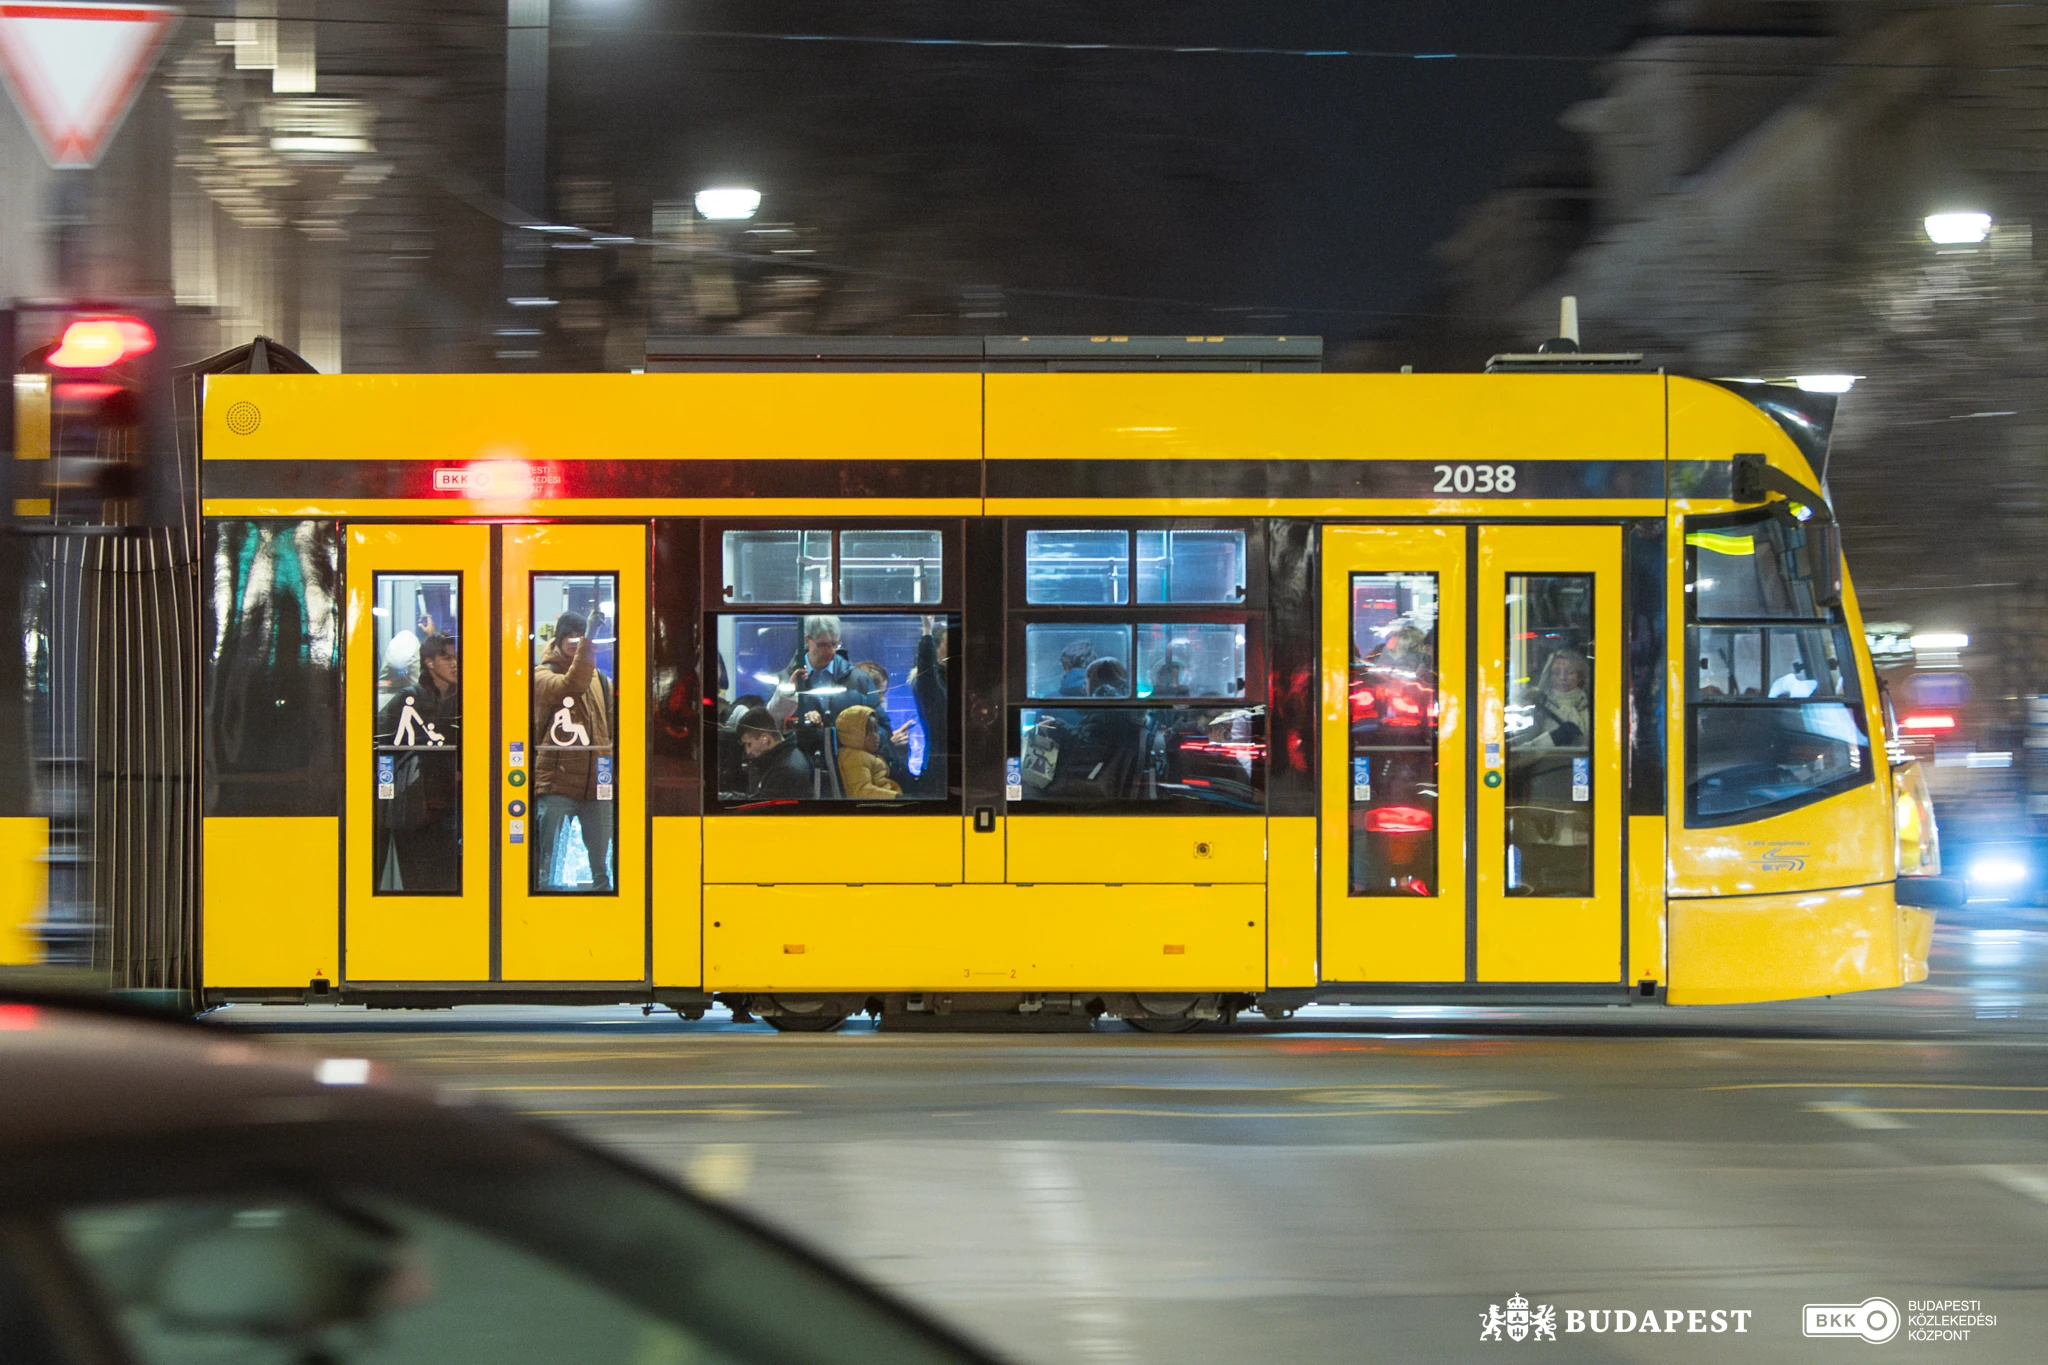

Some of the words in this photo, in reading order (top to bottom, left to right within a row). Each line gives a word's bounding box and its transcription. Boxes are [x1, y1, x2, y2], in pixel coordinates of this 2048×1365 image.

[442, 475, 469, 484] BKK
[1433, 464, 1517, 493] 2038
[964, 969, 970, 978] 3
[1010, 969, 1017, 979] 2
